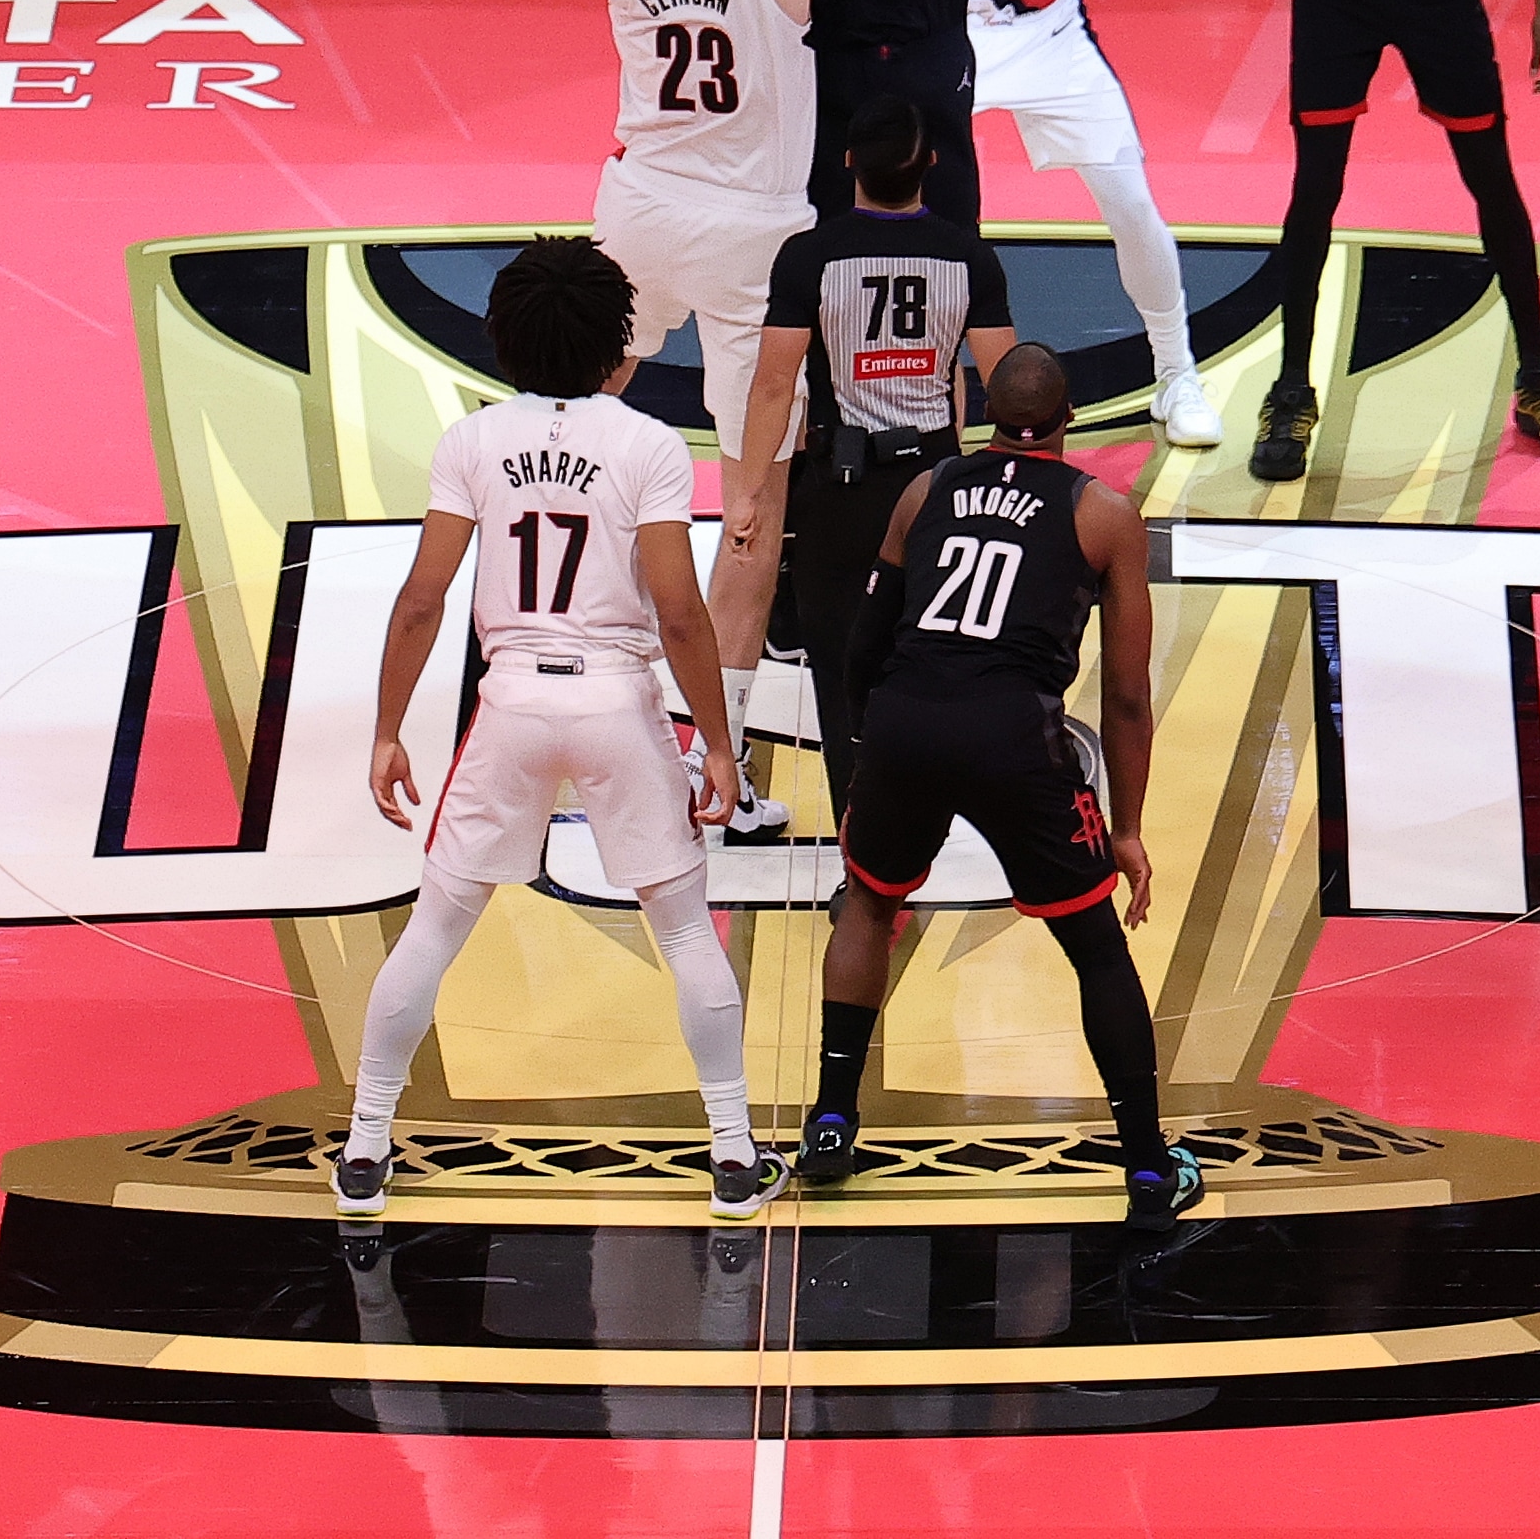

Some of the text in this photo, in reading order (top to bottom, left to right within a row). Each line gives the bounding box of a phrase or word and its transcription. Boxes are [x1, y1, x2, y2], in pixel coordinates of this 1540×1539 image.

[655, 23, 740, 114] 23
[862, 274, 927, 342] 78
[861, 355, 929, 374] Emirates
[502, 449, 602, 495] SHARPE
[953, 486, 1045, 529] OKOGIE
[509, 510, 590, 615] 17
[917, 535, 1024, 641] 20
